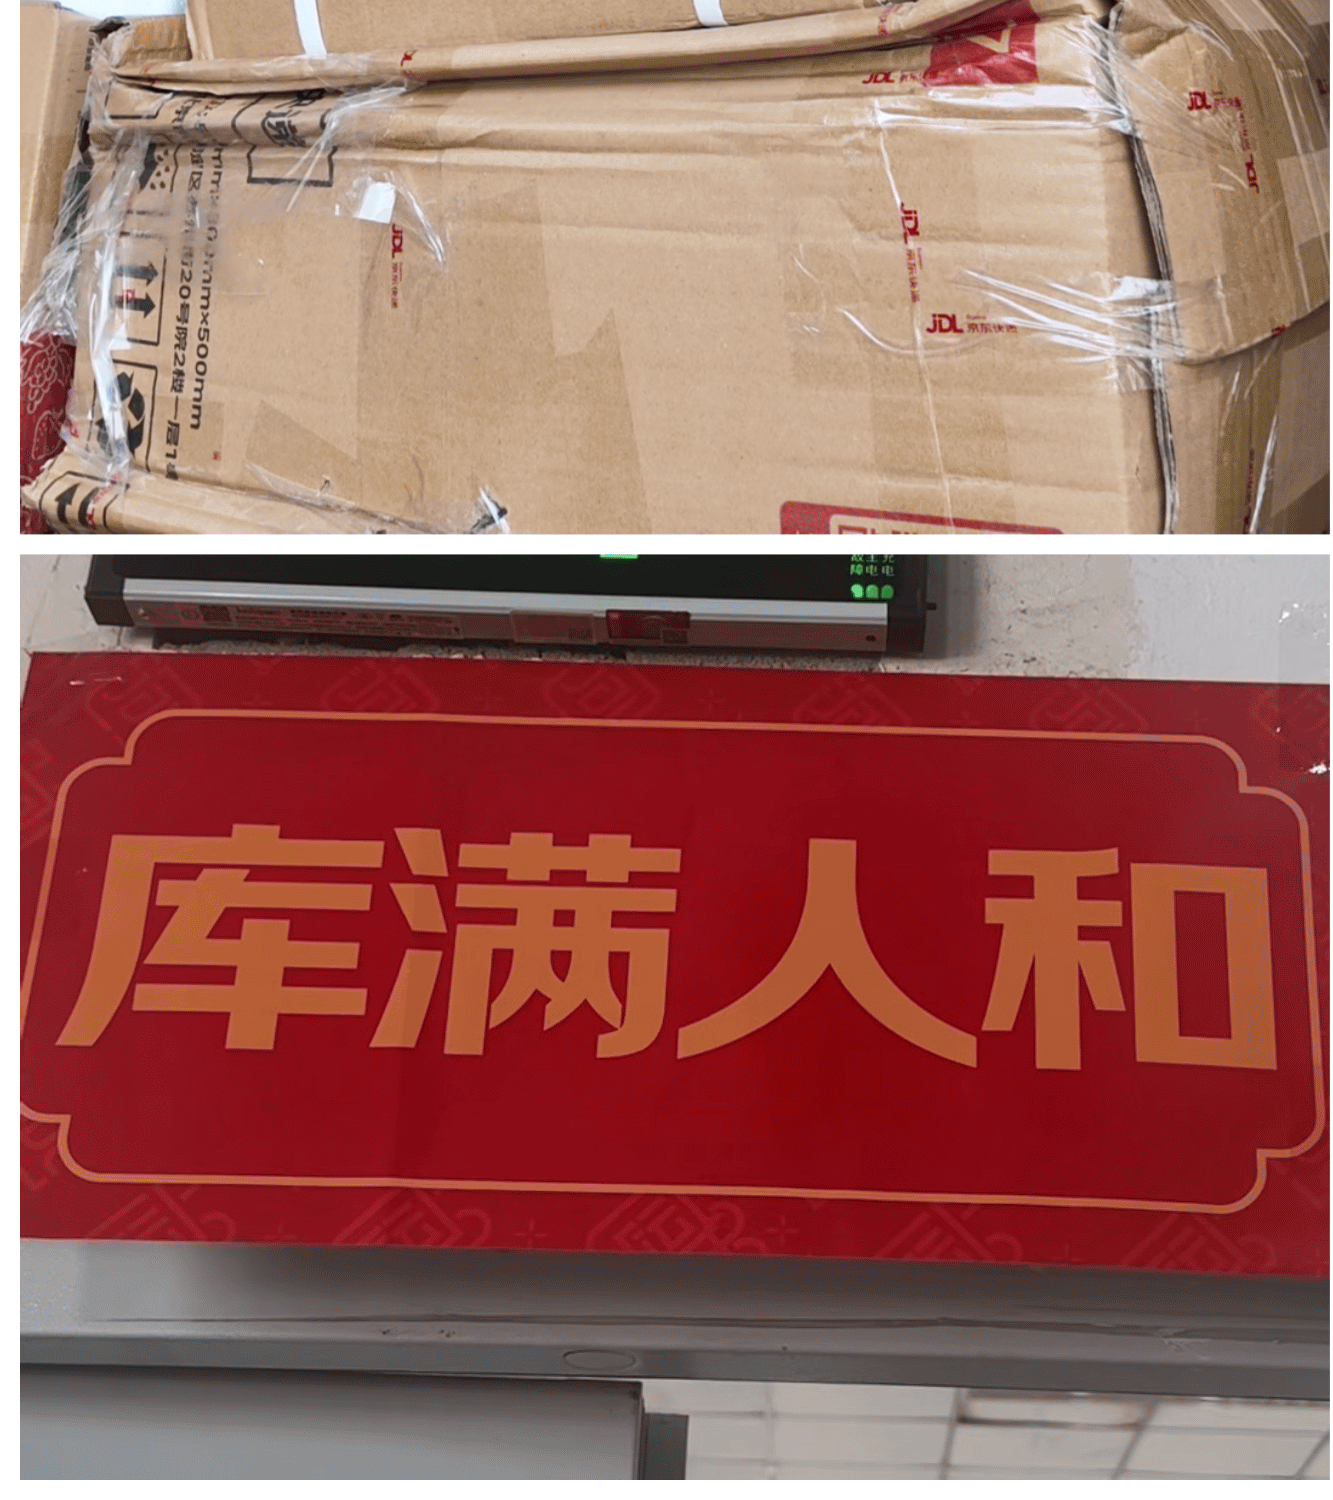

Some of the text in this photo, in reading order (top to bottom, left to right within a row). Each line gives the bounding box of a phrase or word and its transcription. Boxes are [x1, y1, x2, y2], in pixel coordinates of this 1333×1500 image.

[901, 202, 921, 245] JDL
[926, 313, 965, 334] JDL
[55, 823, 1278, 1071] 库满人和
